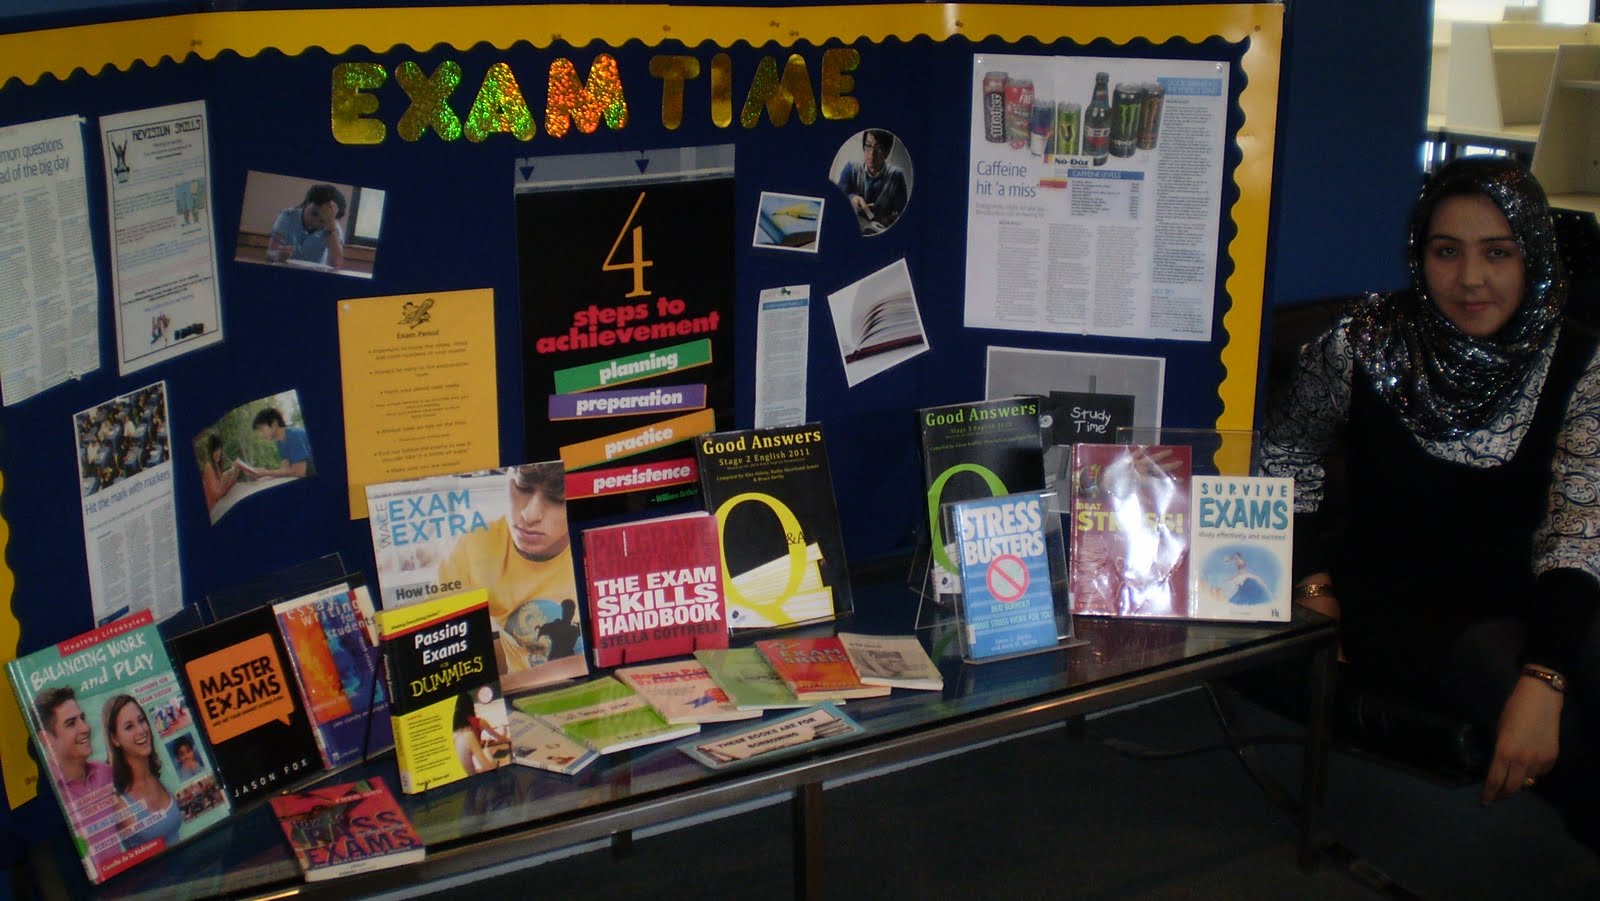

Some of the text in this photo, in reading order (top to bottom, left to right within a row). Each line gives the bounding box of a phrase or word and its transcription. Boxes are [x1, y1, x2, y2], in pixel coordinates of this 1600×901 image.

[331, 48, 860, 145] EXAM TIME
[132, 119, 201, 141] REVISION SKILLS
[22, 138, 64, 160] questions
[12, 164, 21, 181] of
[23, 162, 37, 177] the
[40, 160, 53, 176] big
[54, 155, 70, 172] day
[977, 160, 1028, 178] Caffeine
[976, 180, 992, 195] hit
[602, 191, 653, 298] 4
[573, 297, 686, 328] steps to
[536, 311, 720, 354] achievement
[599, 351, 678, 385] planning
[576, 389, 683, 416] preparation
[925, 403, 1037, 427] Good Answers
[1071, 406, 1111, 427] Study
[604, 425, 673, 460] practice
[703, 430, 822, 455] Good Answers
[1074, 420, 1107, 434] Time
[719, 458, 743, 467] Stage
[753, 451, 786, 462] English
[788, 448, 810, 457] 2011
[86, 469, 170, 516] Hit the mark with markers
[593, 465, 691, 494] persistence
[1201, 482, 1287, 498] SURVIVE
[388, 489, 471, 522] EXAM
[963, 500, 1042, 541] STRESS
[1199, 497, 1288, 530] EXAMS
[375, 502, 393, 549] WACE
[392, 511, 489, 547] EXTRA
[1077, 511, 1184, 533] STSS!
[964, 531, 1045, 567] BUSTERS
[396, 580, 462, 600] How to ace
[594, 566, 717, 597] THE EXAM
[286, 598, 337, 621] essay
[301, 600, 360, 627] writing
[597, 583, 718, 617] SKILLS
[325, 616, 376, 638] students
[341, 613, 356, 624] for
[598, 602, 721, 637] HANDBOOK
[63, 617, 146, 653] Healthy Lifestyles
[414, 621, 468, 650] Passing
[600, 622, 718, 649] STELLA COTTRELL
[30, 632, 146, 692] BALANCING WORK
[423, 640, 468, 666] Exams
[80, 652, 154, 692] and PLAY
[200, 656, 274, 699] MASTER
[409, 656, 483, 697] DUMMIES
[205, 674, 281, 720] EXAMS
[718, 717, 816, 749] THESE BOOKS ARE FOR
[235, 758, 307, 798] JASON FOX
[304, 828, 415, 869] EXAMS
